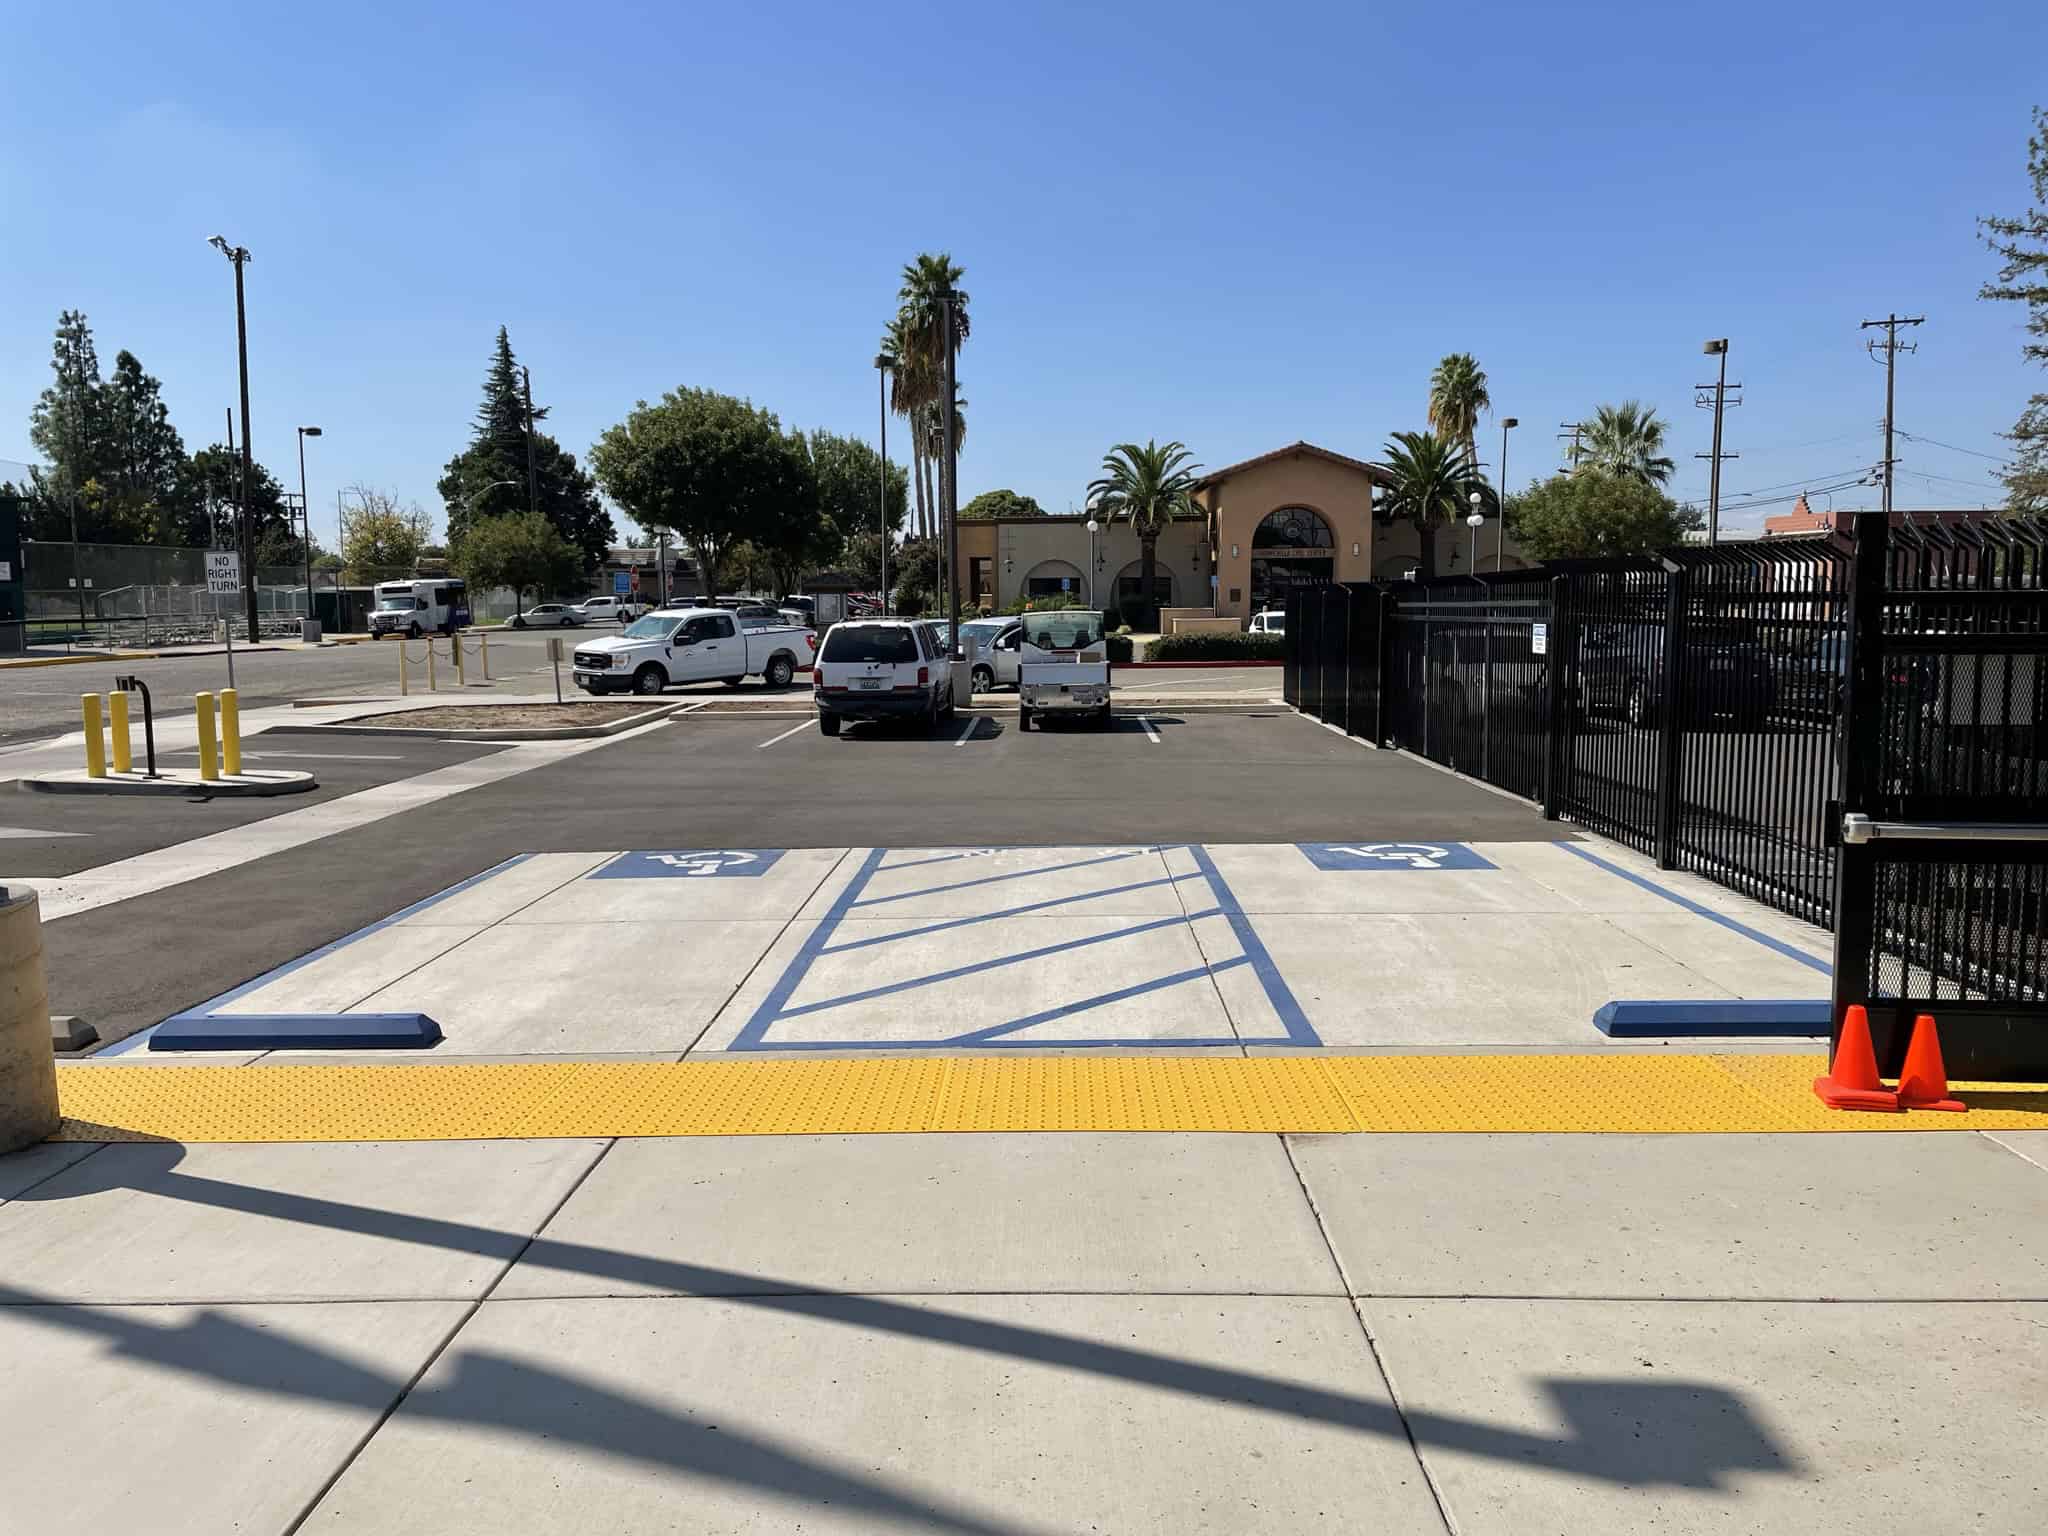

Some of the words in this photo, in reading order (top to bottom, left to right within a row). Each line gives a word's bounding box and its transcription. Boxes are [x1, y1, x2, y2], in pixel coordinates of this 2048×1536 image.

[215, 556, 229, 567] NO
[208, 569, 237, 579] RIGHT
[209, 581, 238, 592] TURN
